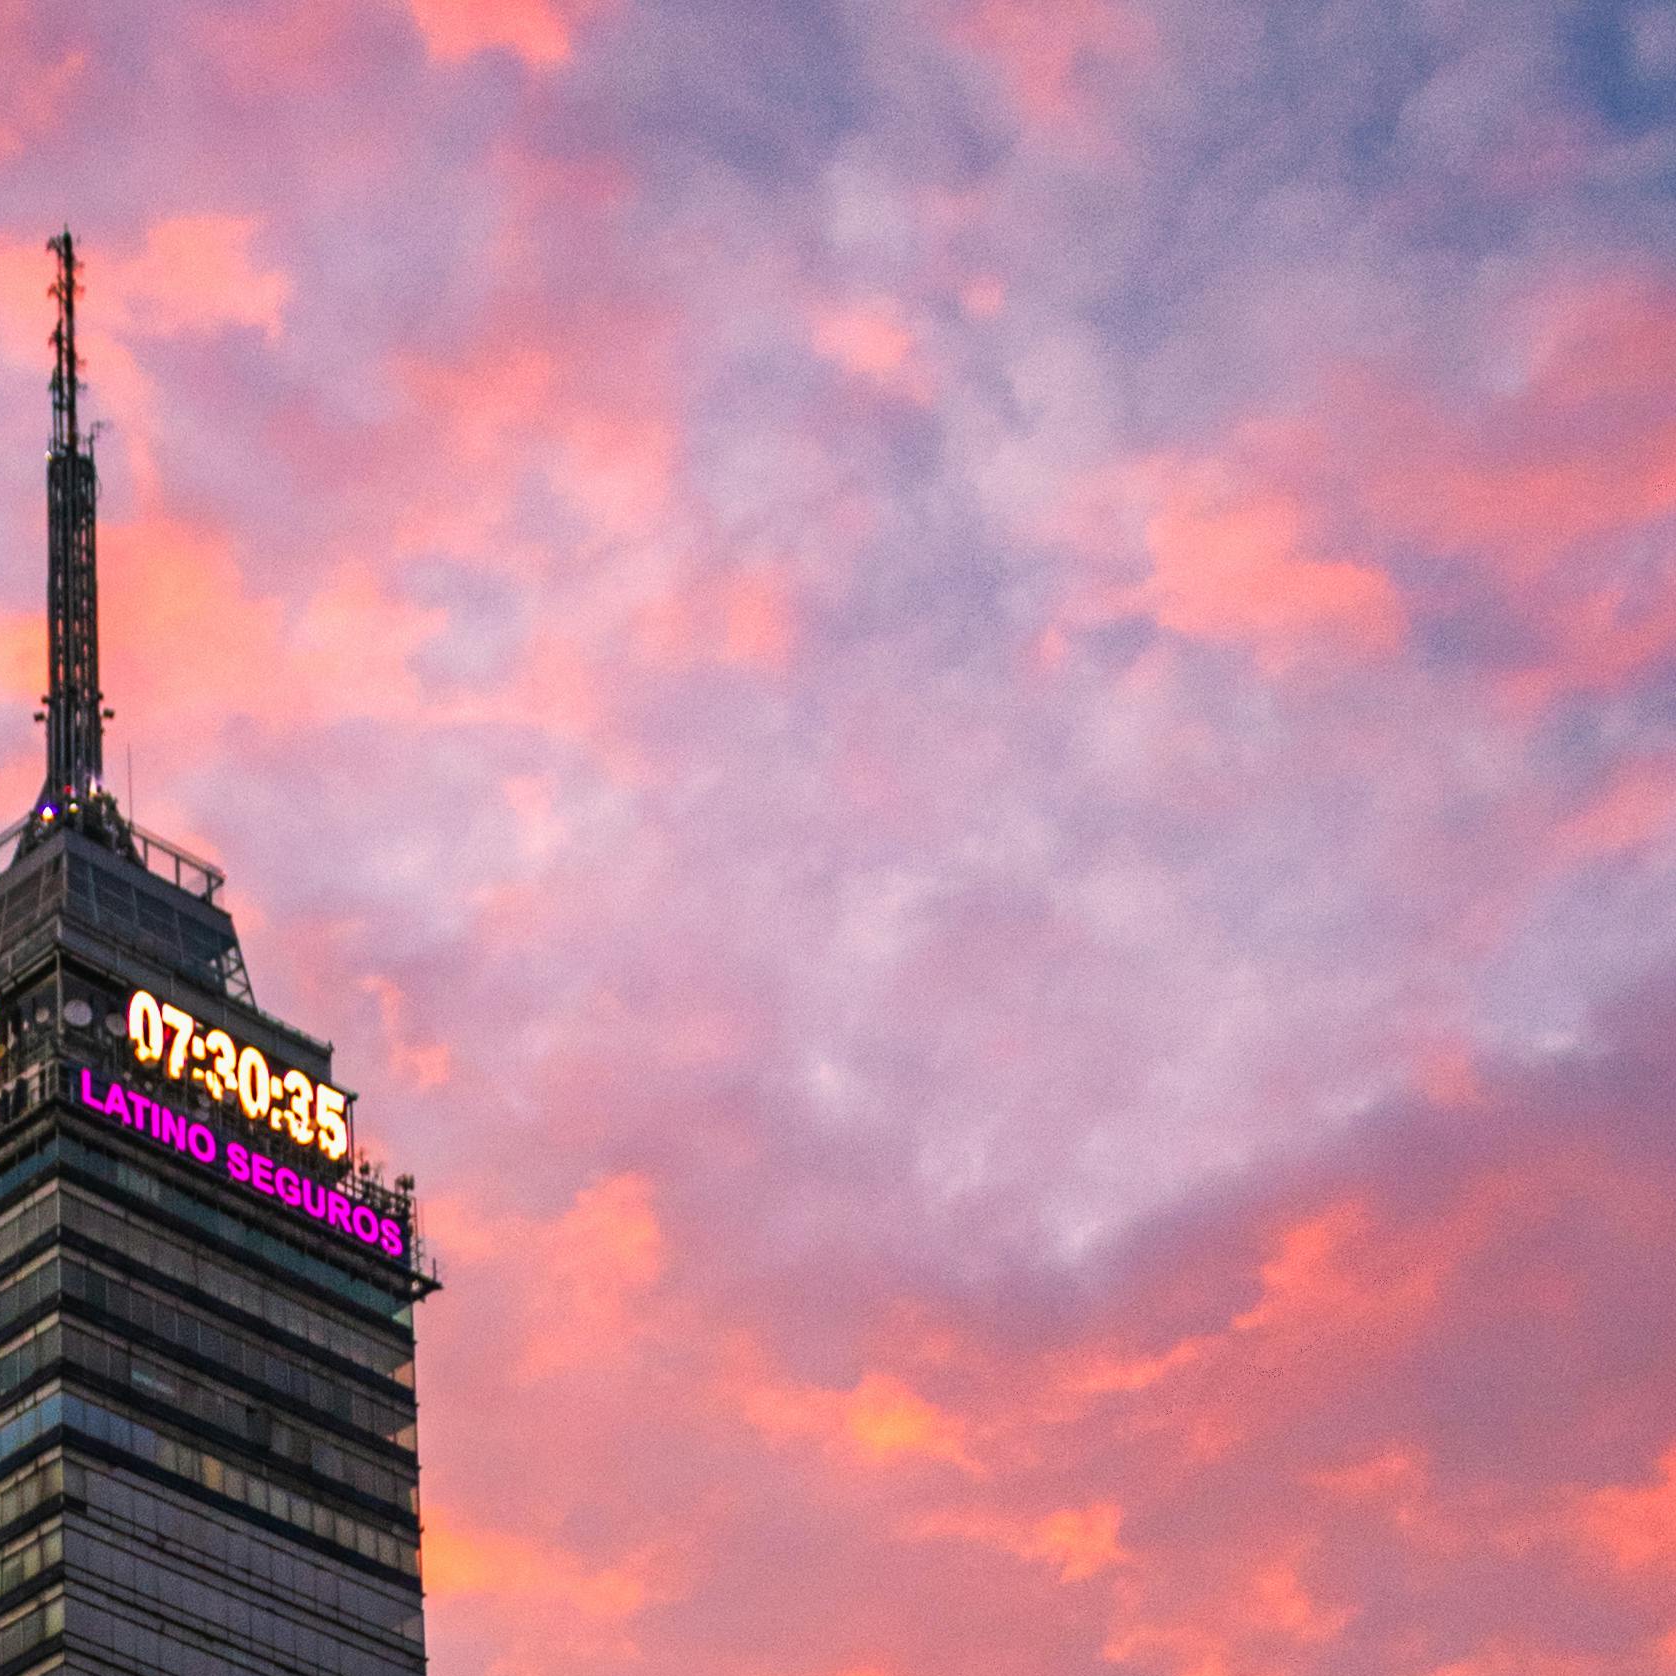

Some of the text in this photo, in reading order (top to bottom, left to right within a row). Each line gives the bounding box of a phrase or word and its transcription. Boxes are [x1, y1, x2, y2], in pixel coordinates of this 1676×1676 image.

[80, 1069, 404, 1258] LATINO SEGUROS
[127, 989, 349, 1161] 07:30:35
